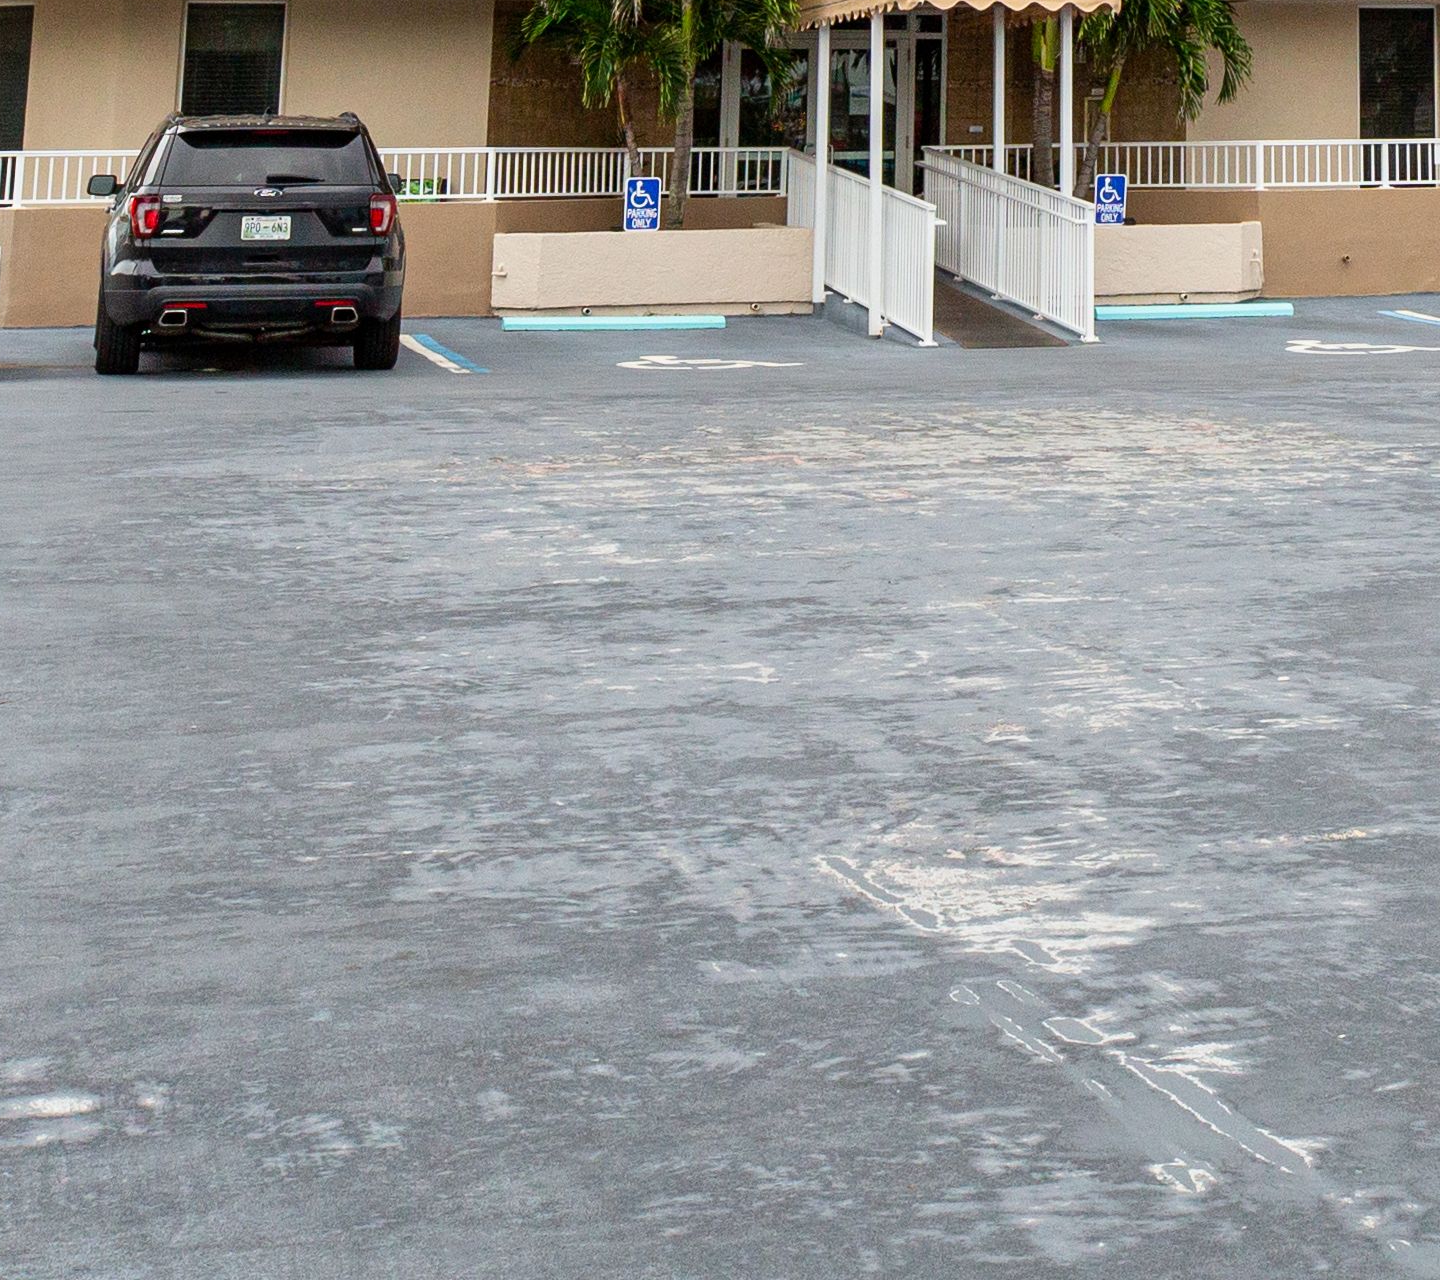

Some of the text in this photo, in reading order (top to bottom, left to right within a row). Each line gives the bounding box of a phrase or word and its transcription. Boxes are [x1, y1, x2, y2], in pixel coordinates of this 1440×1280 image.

[1097, 203, 1123, 213] PARKING
[627, 208, 657, 219] PARKING
[1101, 213, 1118, 223] ONLY
[632, 218, 652, 228] ONLY
